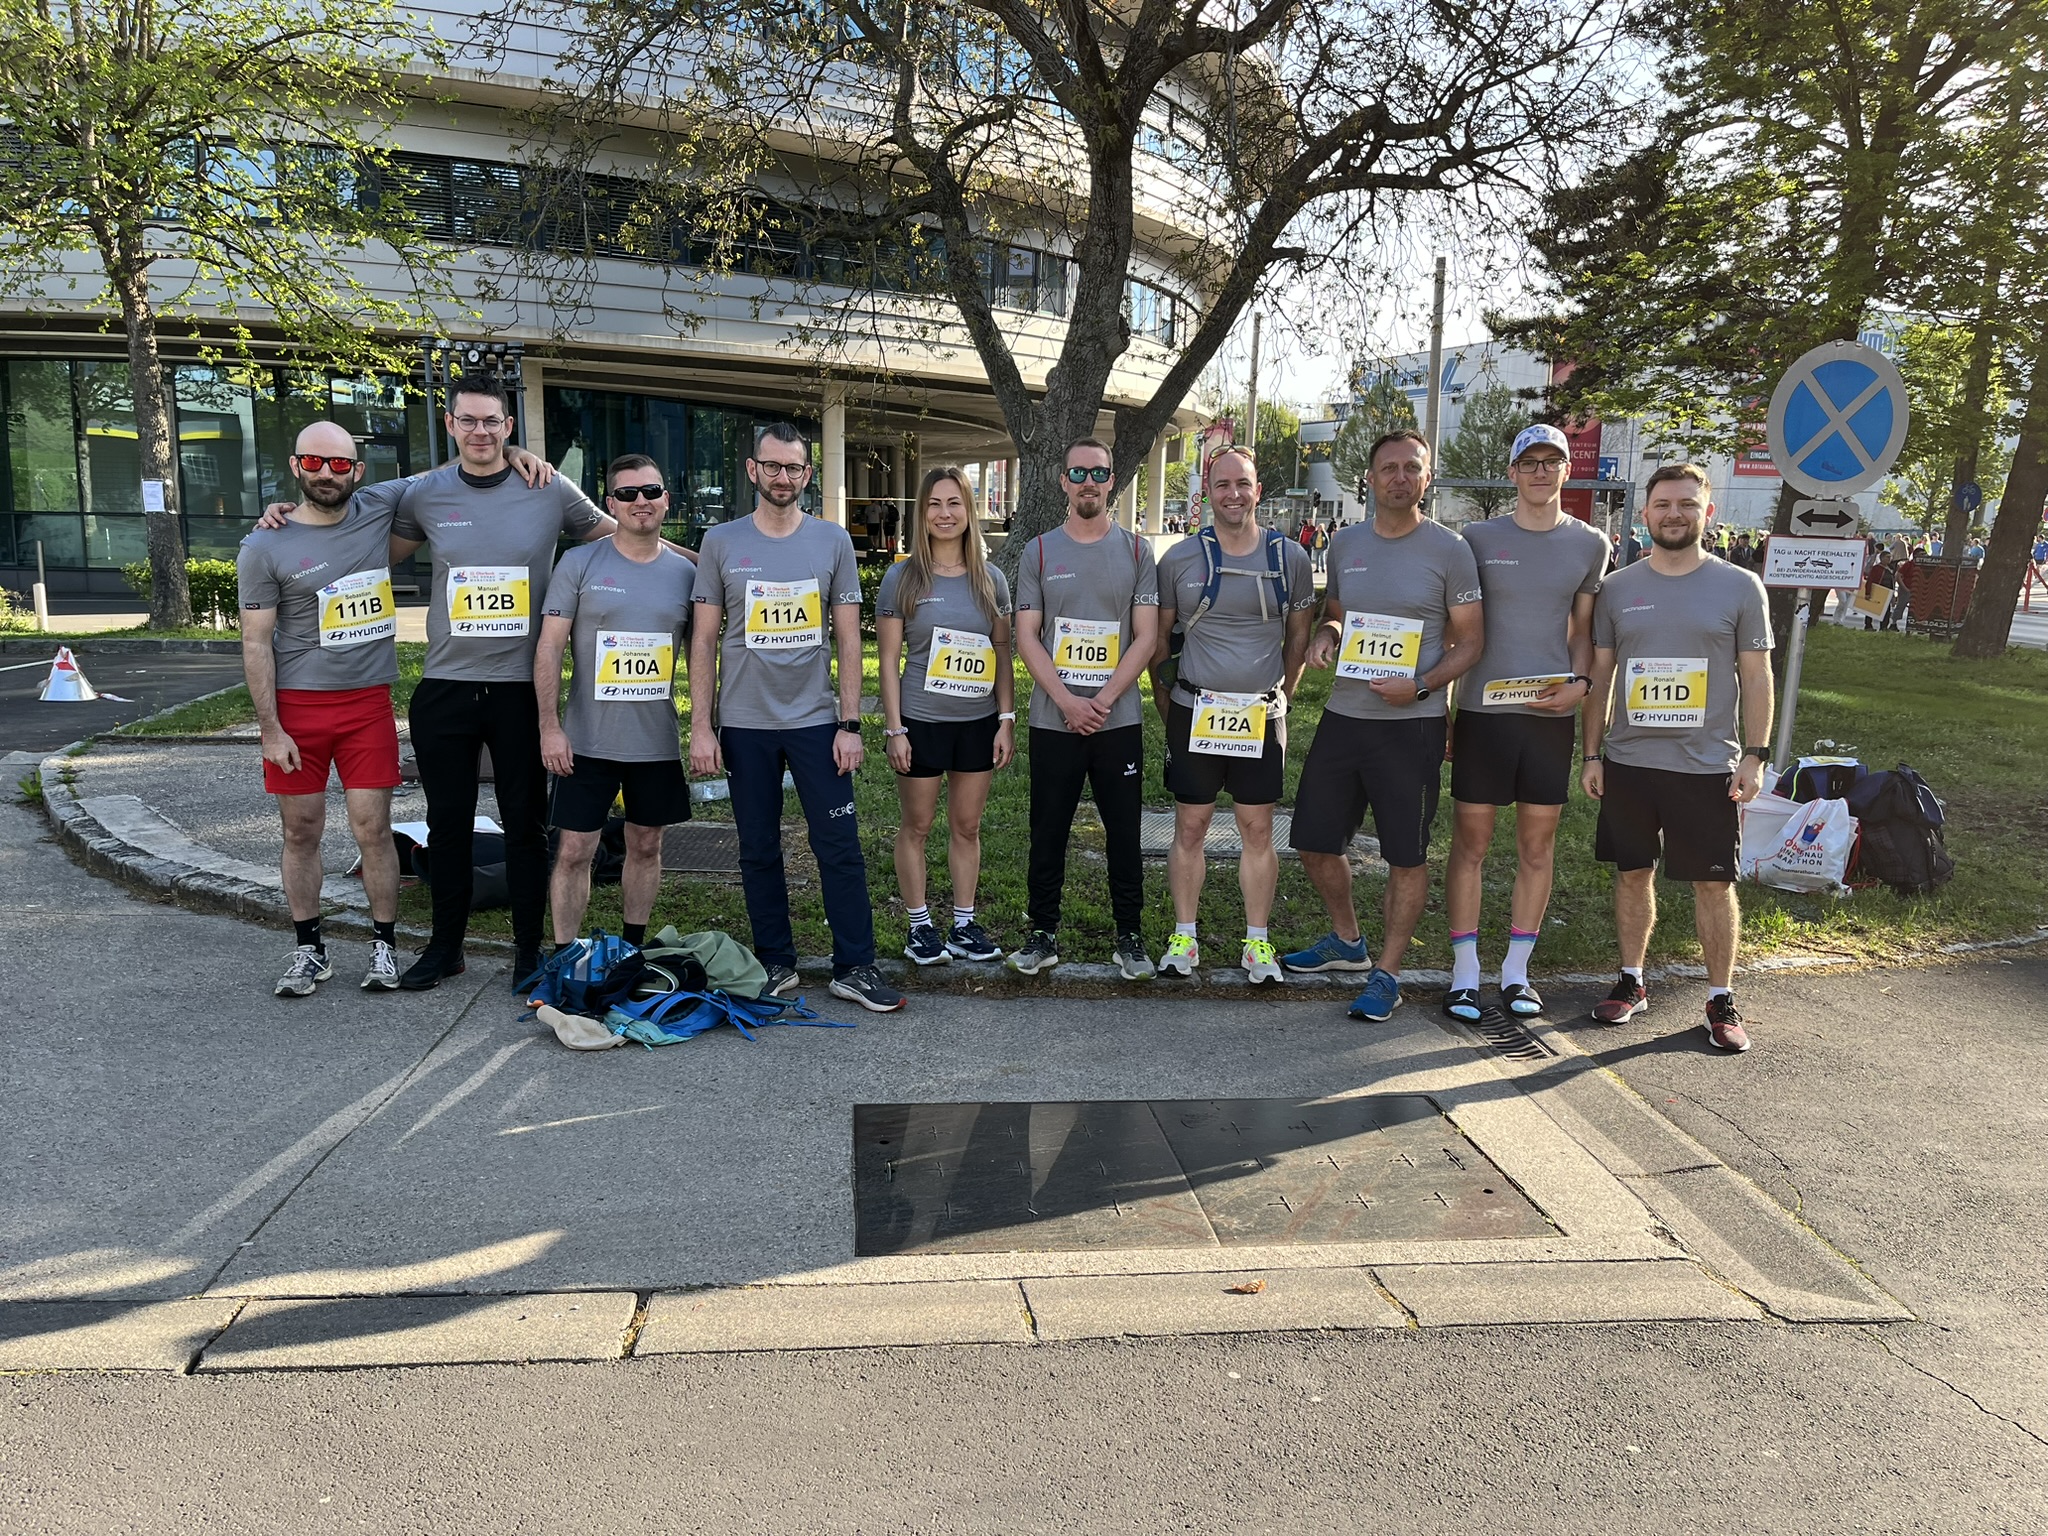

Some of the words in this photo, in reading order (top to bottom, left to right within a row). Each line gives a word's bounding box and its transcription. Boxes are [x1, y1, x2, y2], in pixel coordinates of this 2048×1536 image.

[436, 520, 473, 528] technosert
[291, 561, 329, 580] technosert
[729, 566, 763, 574] technosert
[344, 591, 372, 600] Sebastian
[590, 584, 627, 594] technosert
[335, 597, 382, 618] 111B
[464, 594, 515, 610] 112B
[760, 607, 808, 624] 111A
[349, 622, 392, 638] HYUNDAI
[476, 622, 524, 631] HYUNDAI
[771, 634, 816, 644] HYUNDAI
[1066, 644, 1108, 662] 110B
[1357, 638, 1404, 658] 111C
[612, 658, 660, 675] 110A
[944, 654, 985, 674] 110D
[622, 688, 666, 696] HYUNDAI
[949, 682, 988, 694] HYUNDAI
[1508, 690, 1541, 698] HYUN
[1640, 684, 1690, 700] 111D
[1208, 714, 1252, 732] 112A
[1648, 714, 1698, 722] HYUNDAI
[1214, 742, 1257, 752] HYUNDAI
